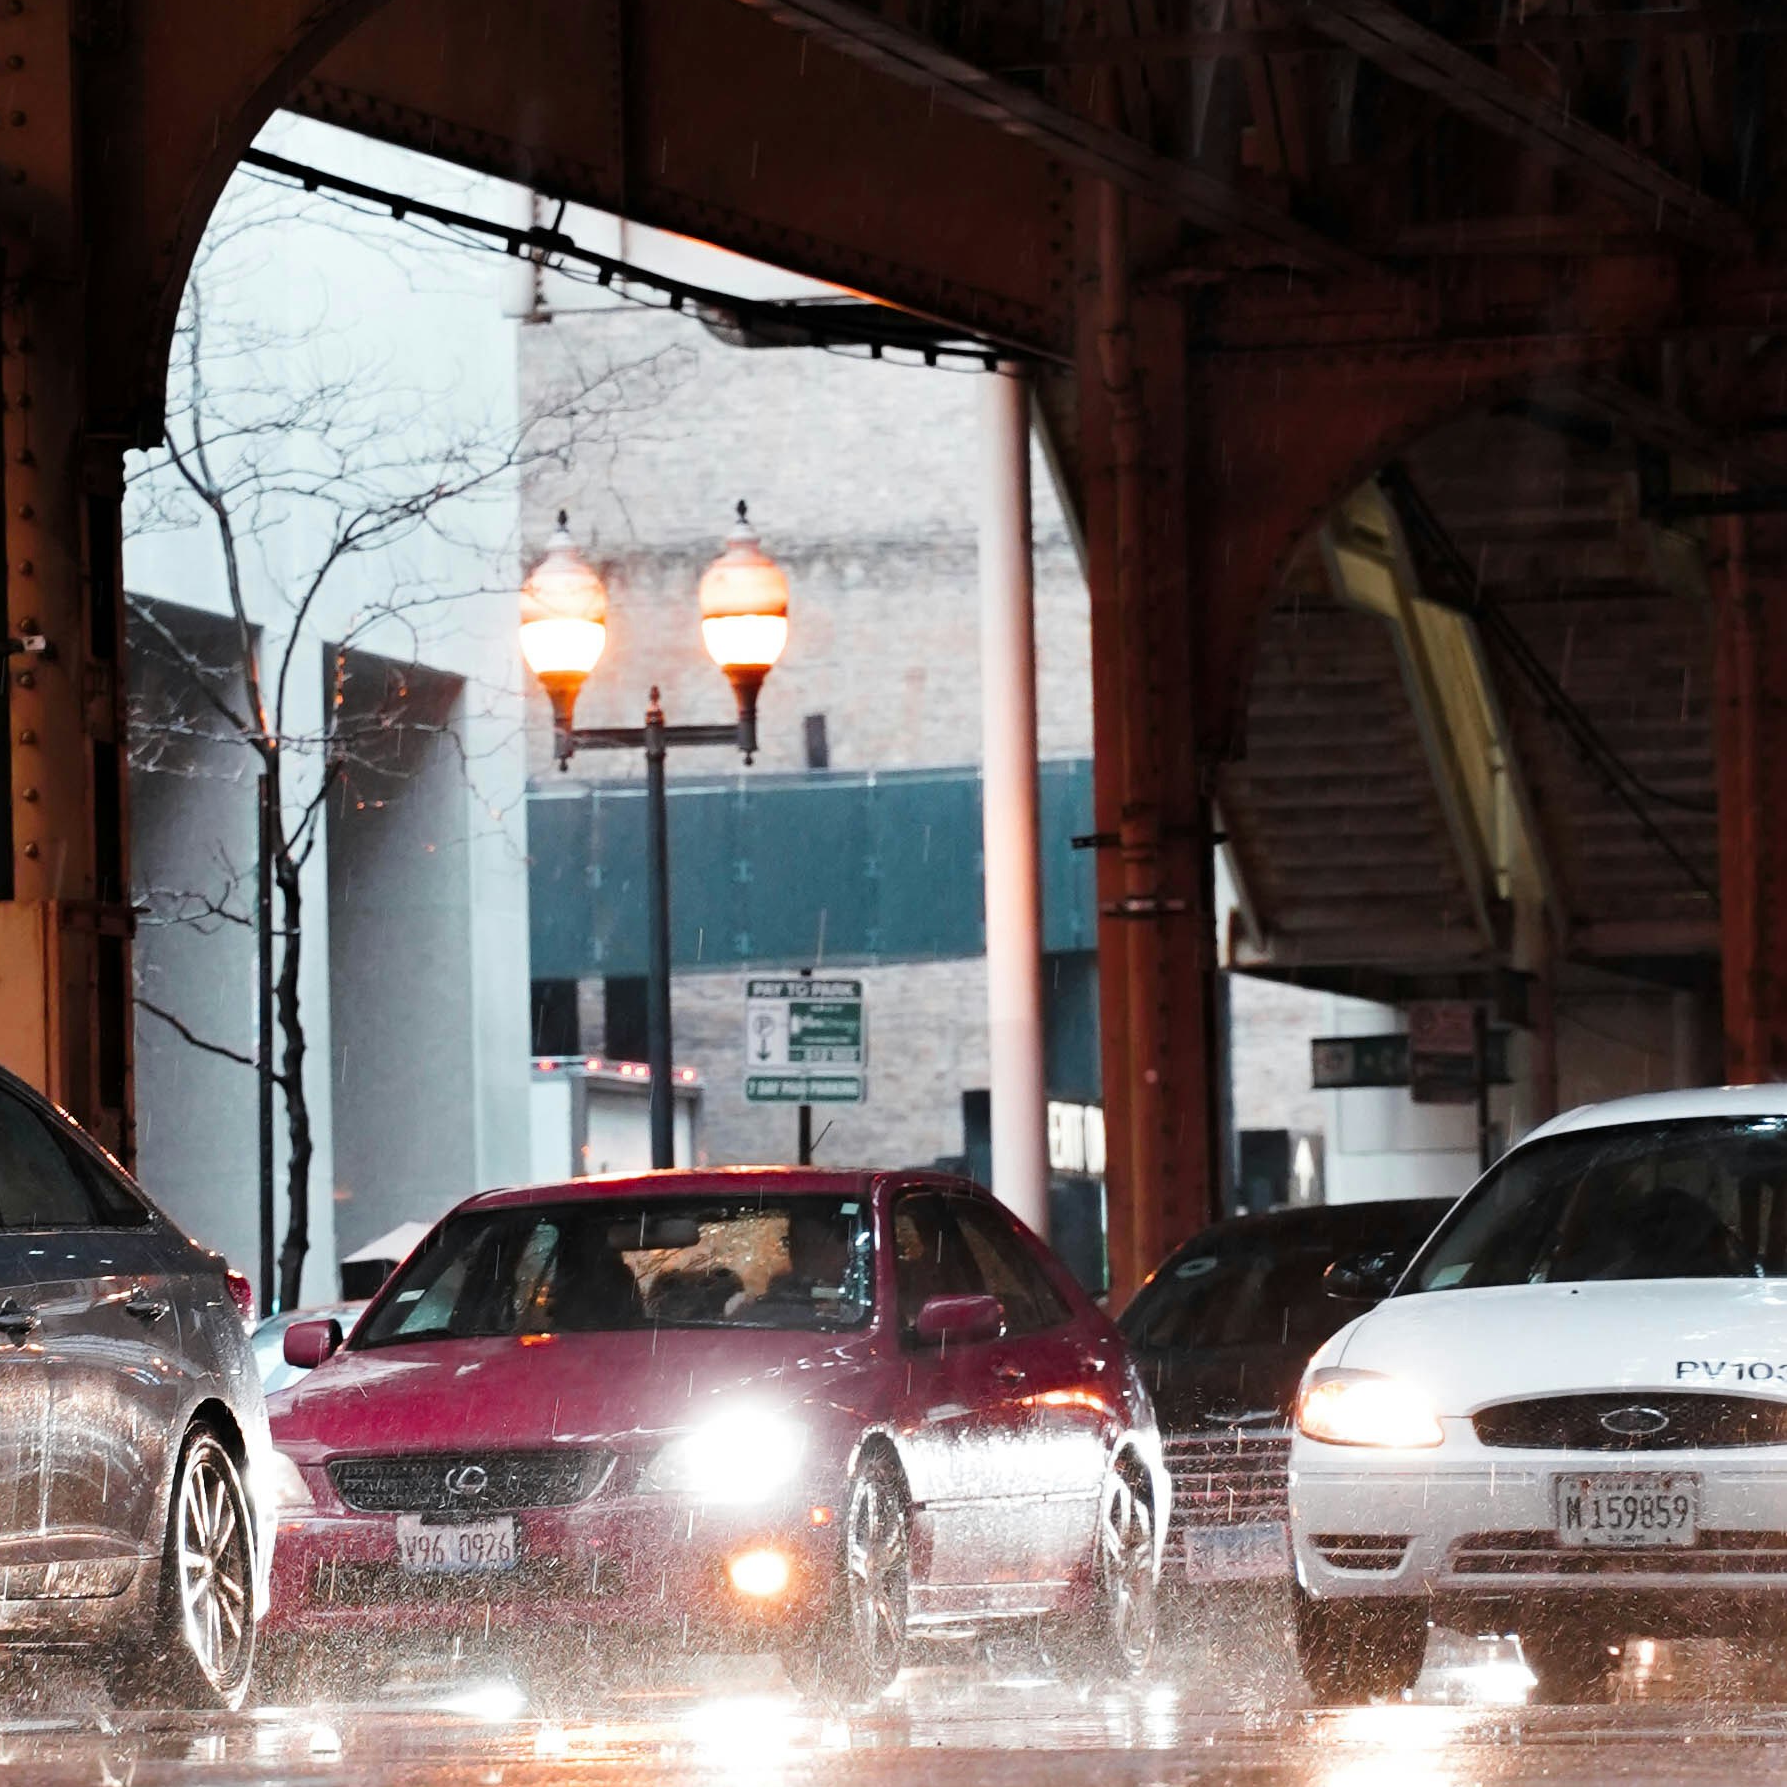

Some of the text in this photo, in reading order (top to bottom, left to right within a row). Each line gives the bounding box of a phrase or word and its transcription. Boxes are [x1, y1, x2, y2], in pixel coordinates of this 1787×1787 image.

[788, 981, 810, 997] TO
[1566, 1495, 1689, 1530] M 159859
